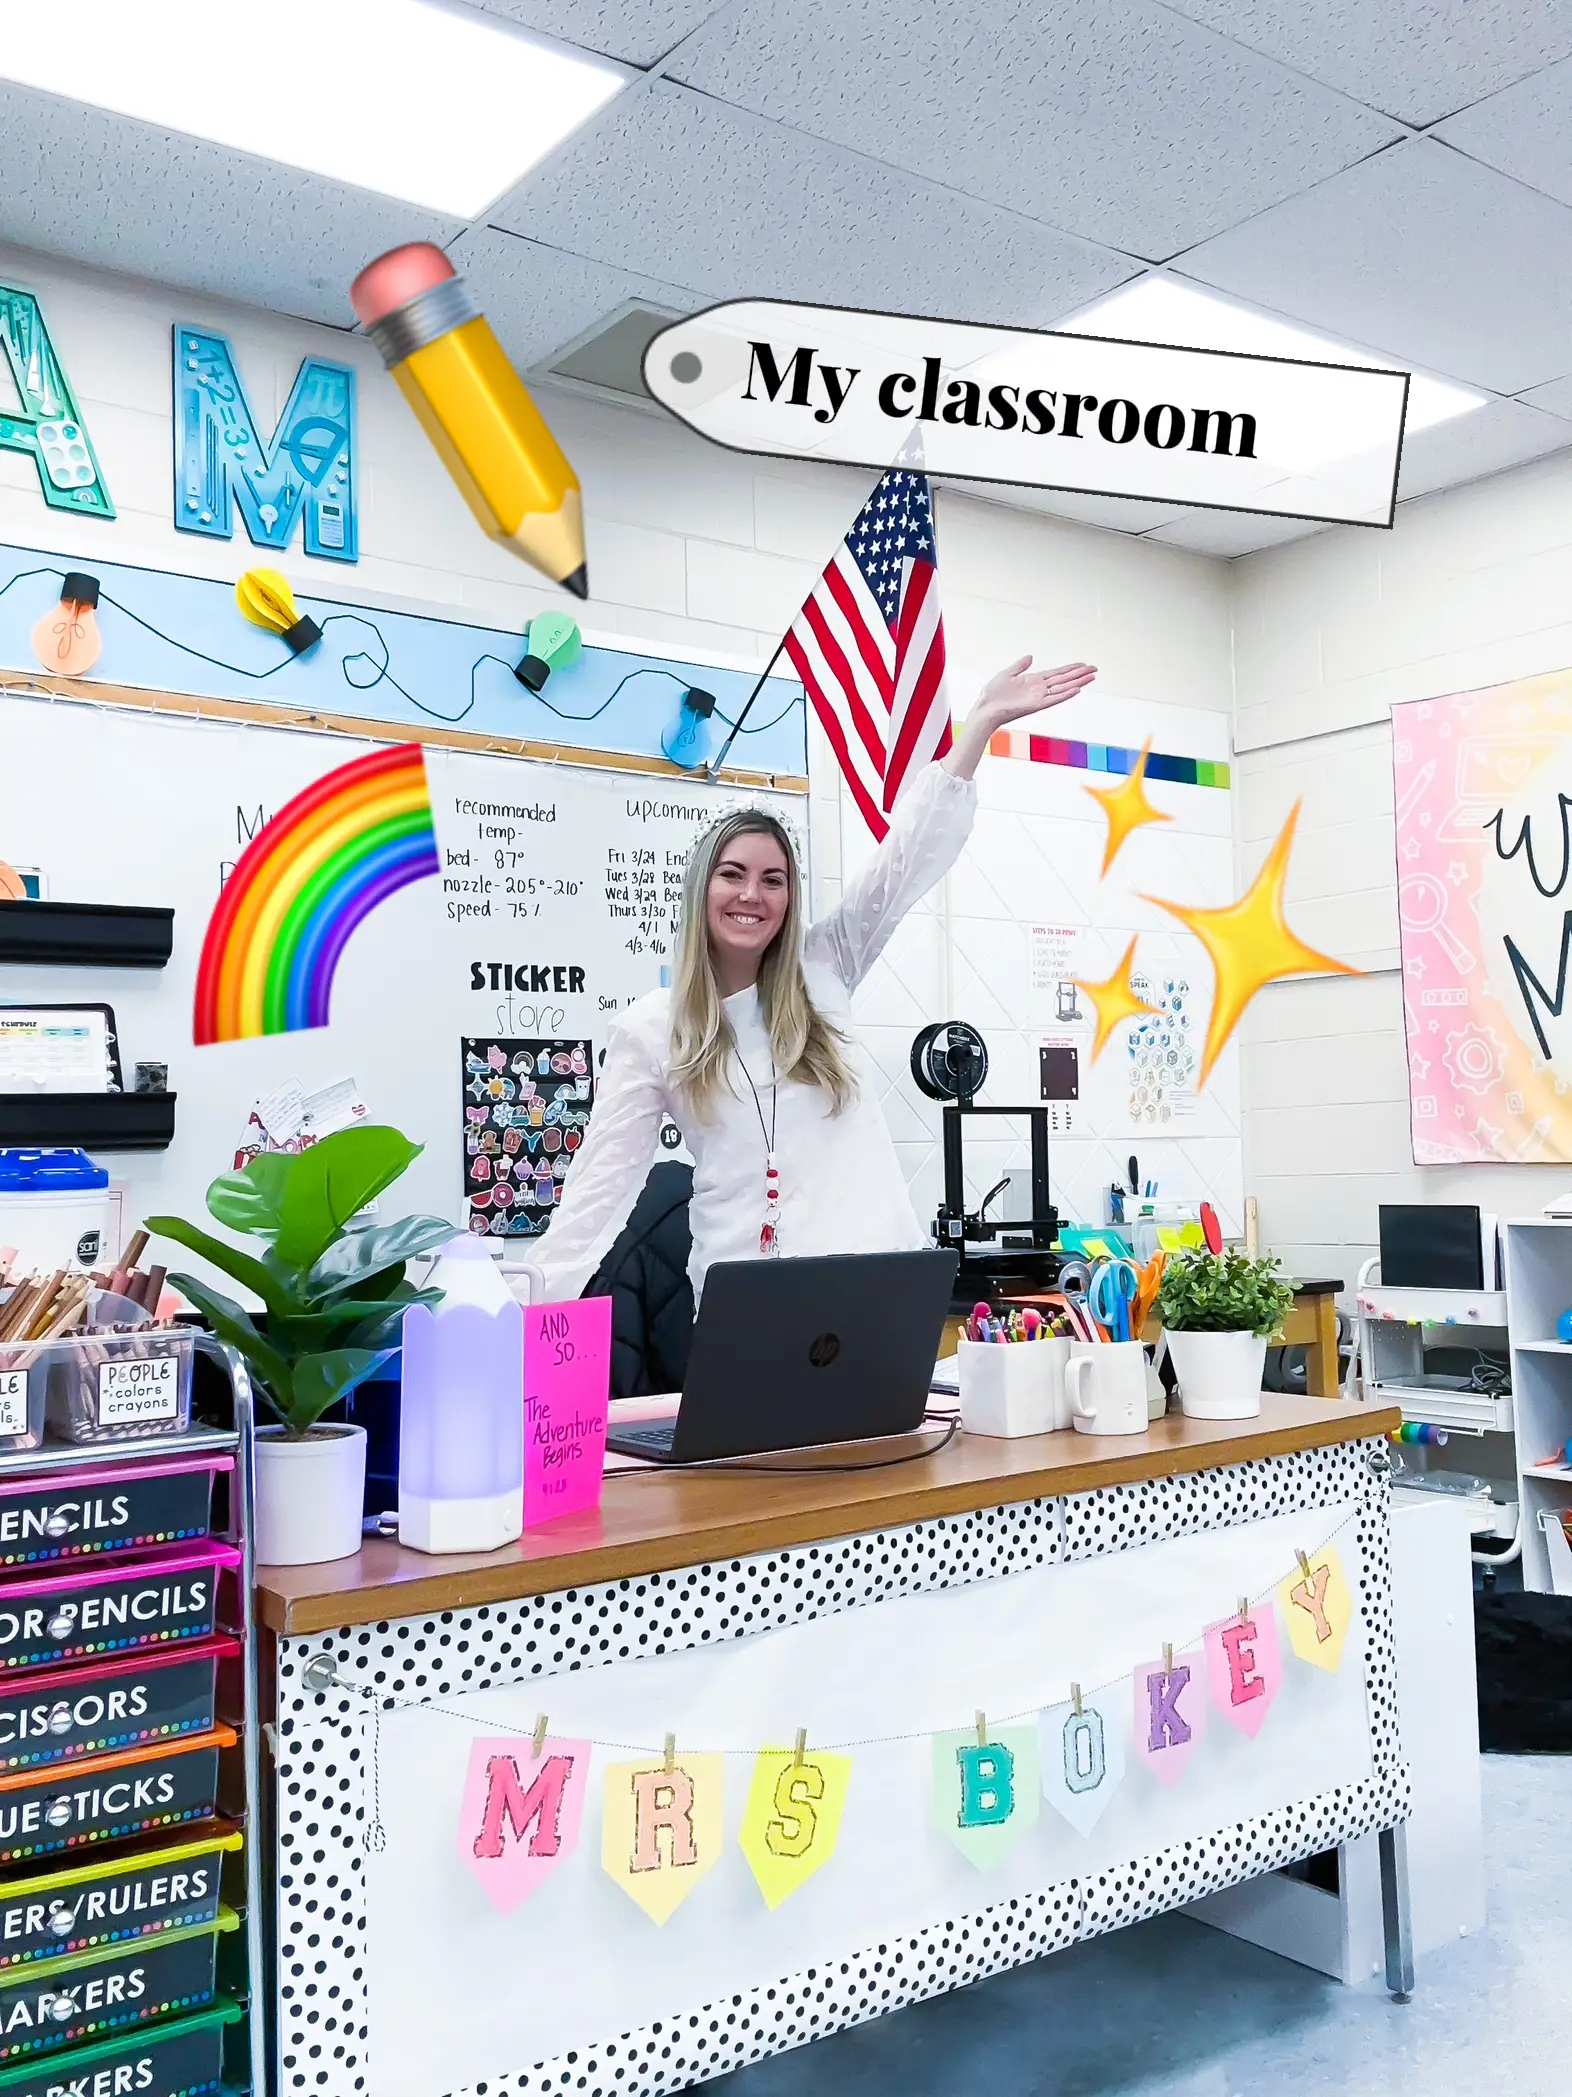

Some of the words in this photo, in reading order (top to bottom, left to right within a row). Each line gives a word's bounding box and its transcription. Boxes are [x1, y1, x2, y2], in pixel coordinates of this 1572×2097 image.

[455, 798, 556, 823] recommended
[626, 799, 708, 823] Upcomin
[608, 848, 625, 864] Fri
[631, 849, 655, 866] 3/24
[605, 868, 627, 883] Tues
[631, 869, 655, 886] 3/28
[663, 871, 685, 884] Bea
[605, 886, 629, 901] Wed
[608, 904, 637, 917] Thurs
[641, 904, 666, 918] 3/30
[470, 961, 586, 994] STICKER
[496, 992, 565, 1035] store
[598, 995, 617, 1011] Sun
[664, 1129, 678, 1143] 18
[540, 1313, 569, 1342] AND
[109, 1362, 170, 1384] PEOPLE
[115, 1384, 162, 1399] colors
[108, 1398, 168, 1414] crayons
[524, 1396, 551, 1422] The
[533, 1411, 603, 1445] Adventure
[543, 1442, 583, 1469] Begins
[0, 1968, 146, 2035] ARKERS
